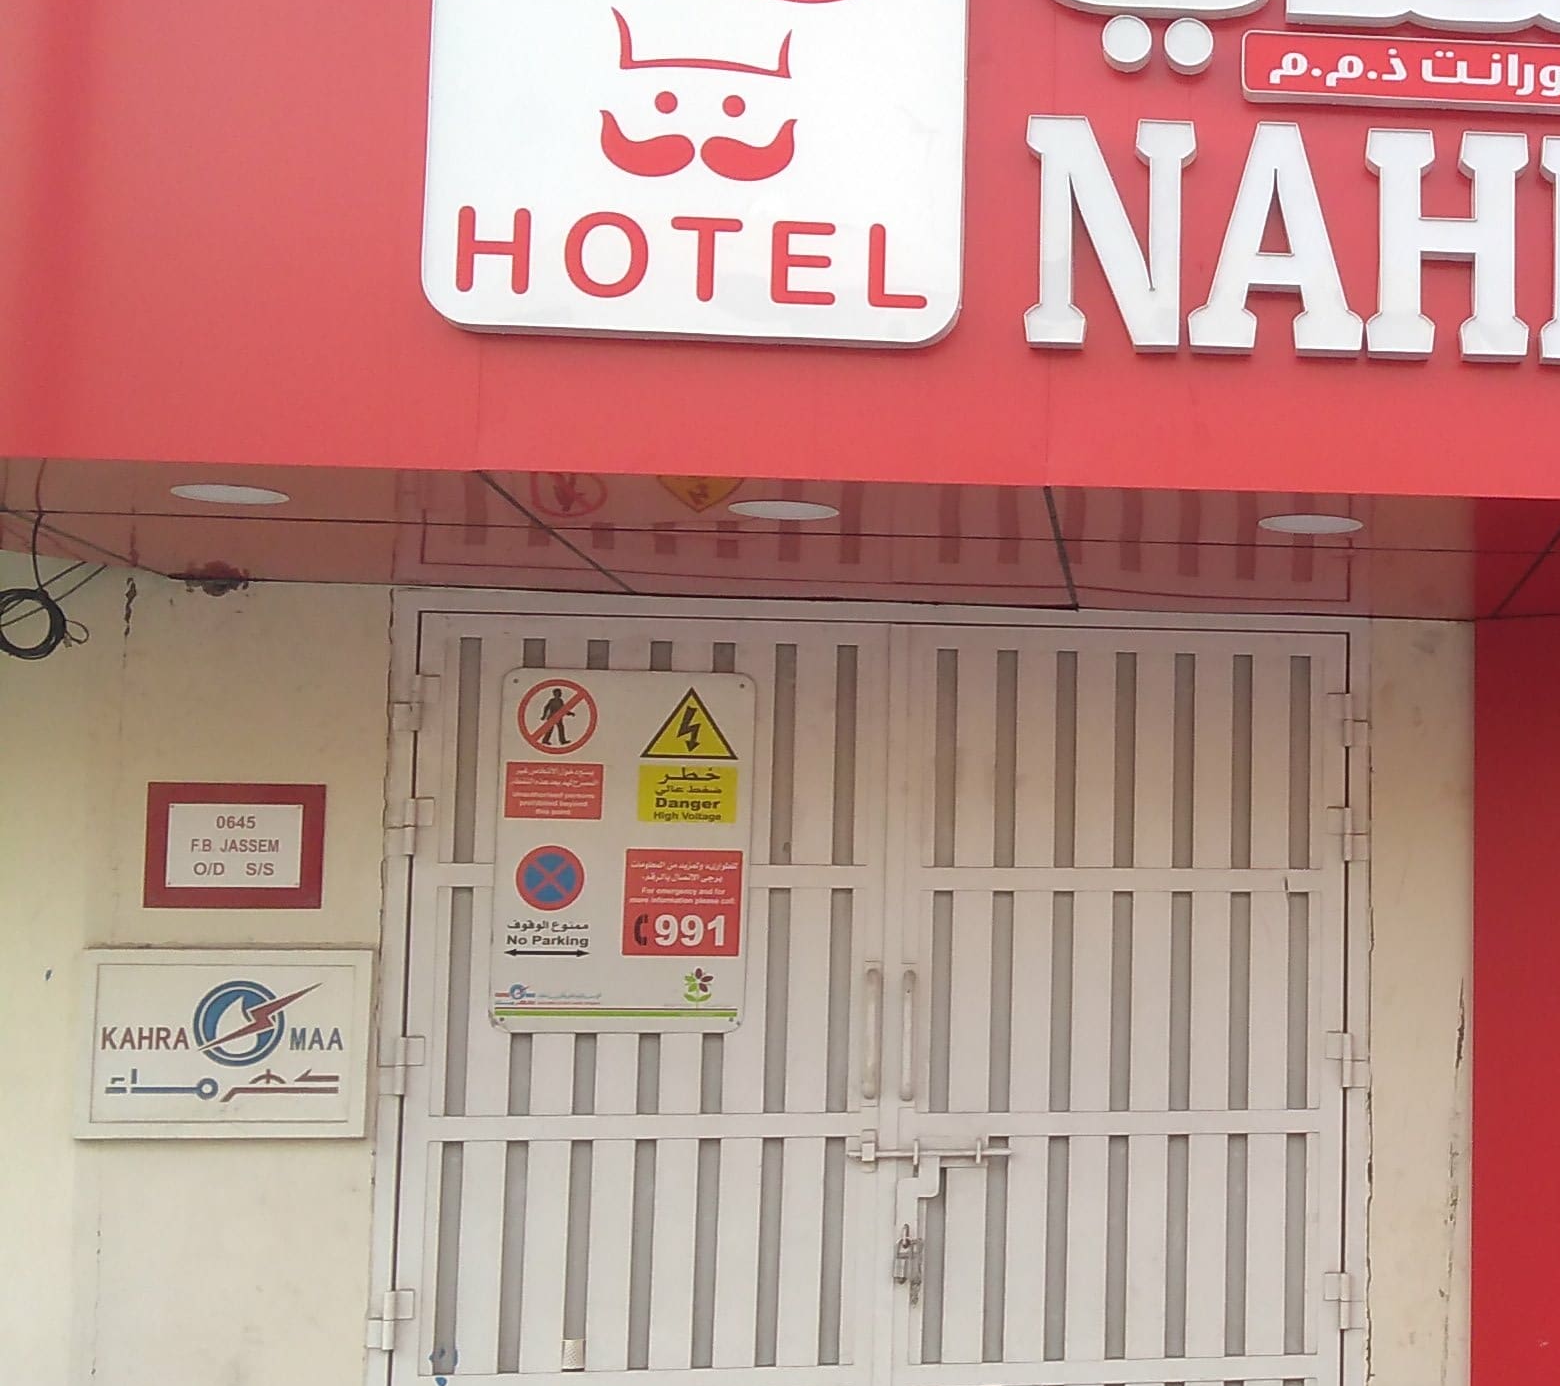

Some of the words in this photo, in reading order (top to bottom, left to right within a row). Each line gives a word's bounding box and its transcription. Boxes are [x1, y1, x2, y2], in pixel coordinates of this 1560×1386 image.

[1269, 48, 1408, 87] ذ.م.م
[456, 205, 928, 310] HOTEL
[657, 766, 721, 785] خطر
[655, 797, 721, 811] Danger
[216, 815, 256, 829] 0645
[653, 811, 679, 821] High
[681, 811, 722, 822] Voltage
[220, 839, 279, 853] JASSEM
[193, 862, 225, 876] O/D
[246, 862, 275, 876] S/S
[654, 913, 725, 947] 991
[506, 934, 528, 945] No
[532, 935, 589, 948] Parking
[101, 1026, 190, 1051] KAHRA
[289, 1027, 343, 1051] MAA
